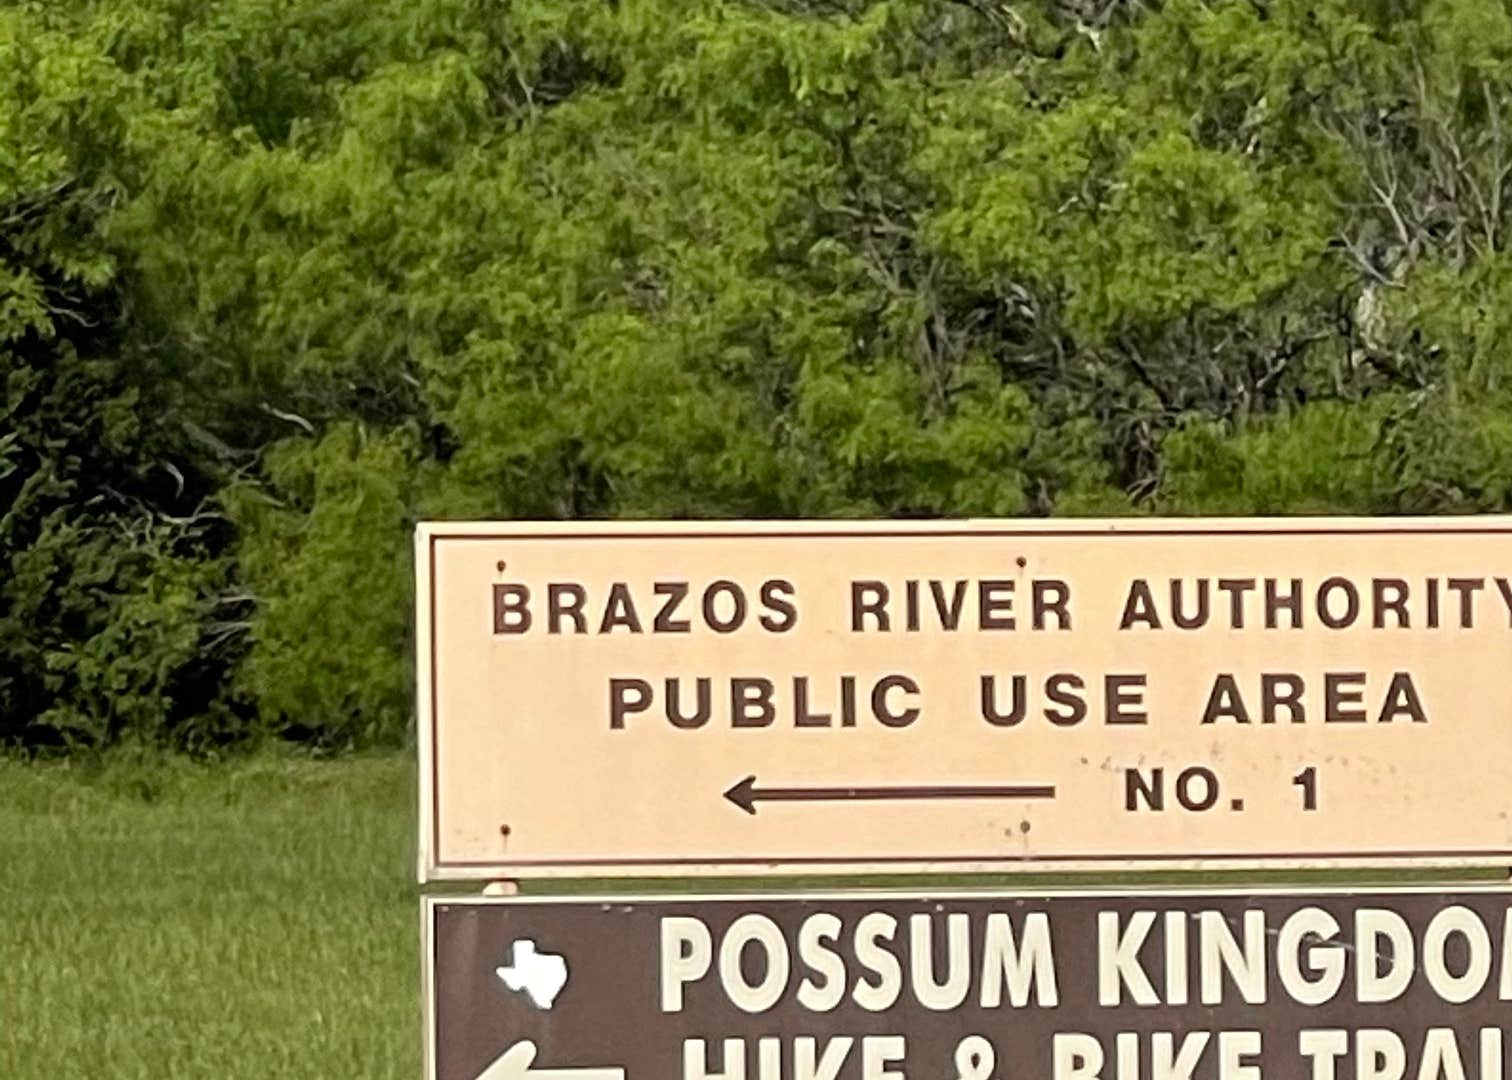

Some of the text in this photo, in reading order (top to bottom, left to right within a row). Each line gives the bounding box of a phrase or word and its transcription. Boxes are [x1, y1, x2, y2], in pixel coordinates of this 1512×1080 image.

[491, 579, 799, 635] BRAZOS
[850, 578, 1073, 633] RIVER
[608, 671, 1429, 731] PUBLIC USE AREA
[1124, 766, 1319, 813] NO. 1
[660, 911, 1059, 1014] POSSUM
